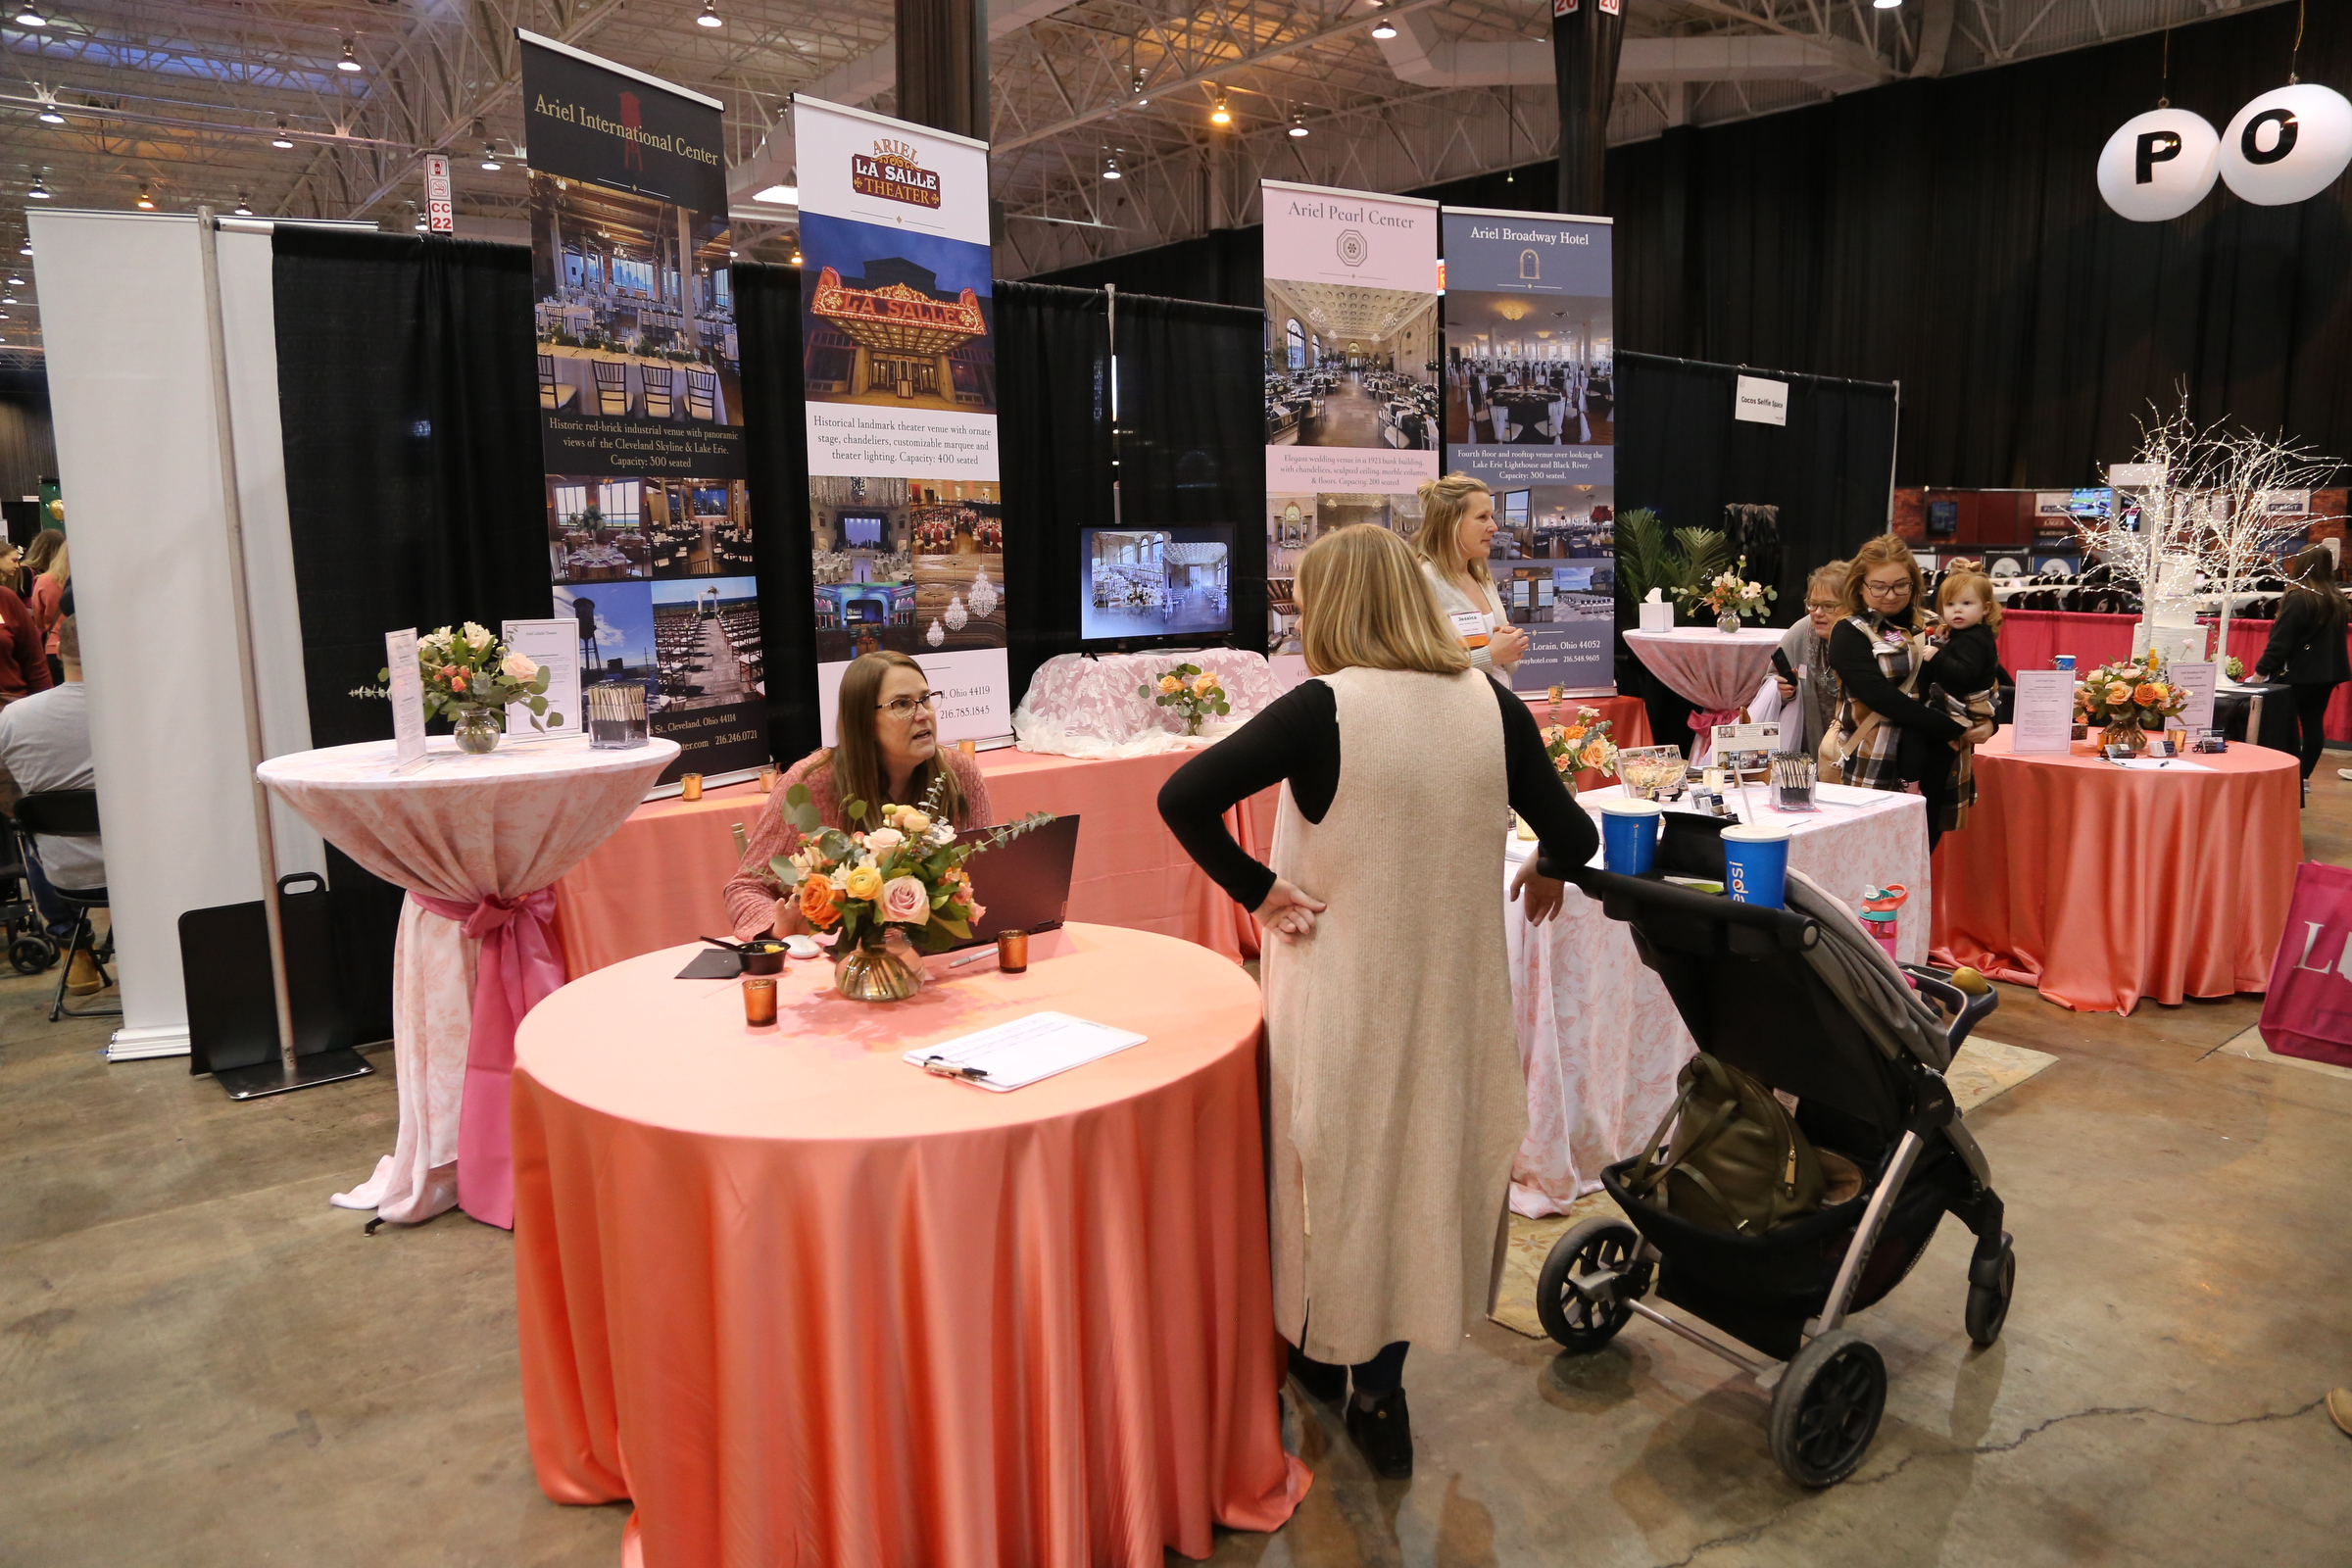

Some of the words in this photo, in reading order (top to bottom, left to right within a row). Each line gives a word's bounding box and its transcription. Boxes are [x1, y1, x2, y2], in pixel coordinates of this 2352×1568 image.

[534, 93, 575, 123] Ariel
[579, 106, 672, 152] International
[675, 137, 718, 166] Center
[873, 138, 919, 165] ARIEL
[2135, 130, 2182, 185] P
[2240, 108, 2299, 166] O
[856, 158, 880, 177] LA
[884, 166, 937, 190] SALLE
[863, 177, 930, 204] THEATER
[431, 202, 451, 214] CC
[1289, 201, 1324, 219] Ariel
[1329, 205, 1364, 222] Pearl
[1368, 210, 1414, 228] Center
[432, 217, 452, 229] 22
[1470, 226, 1499, 240] Ariel
[1502, 227, 1557, 245] Broadway
[1559, 231, 1590, 245] Hotel
[843, 294, 877, 315] LA
[886, 300, 959, 325] SALLE
[1740, 396, 1757, 405] Cocos
[1757, 398, 1771, 407] Selfie
[549, 417, 583, 431] Historic
[585, 419, 622, 433] red-brick
[624, 422, 662, 435] industrial
[662, 428, 685, 437] venue
[686, 426, 703, 438] with
[704, 429, 739, 440] panoramic
[813, 416, 856, 428] Historical
[858, 418, 896, 430] landmark
[898, 421, 925, 432] theater
[951, 424, 967, 435] with
[968, 427, 992, 436] ornate
[563, 437, 585, 447] views
[587, 437, 596, 447] of
[600, 438, 613, 449] the
[614, 438, 654, 451] Cleveland
[656, 439, 684, 454] Skyline
[685, 442, 692, 453] &
[694, 443, 711, 454] Lake
[712, 444, 729, 455] Erie.
[817, 435, 841, 445] stage,
[843, 434, 892, 447] chandeliers,
[893, 438, 943, 449] customizable
[944, 442, 975, 453] marquee
[976, 441, 989, 451] and
[611, 454, 648, 468] Capacity:
[650, 456, 667, 466] 300
[668, 458, 692, 467] seated
[832, 450, 861, 461] theater
[863, 451, 898, 464] lighting.
[900, 452, 936, 465] Capacity:
[937, 454, 955, 464] 400
[956, 455, 979, 465] seated
[1284, 454, 1308, 466] Elegant
[1309, 455, 1336, 466] wedding
[1382, 457, 1397, 466] bank
[1457, 449, 1480, 458] Fourth
[1481, 449, 1497, 458] floor
[1511, 450, 1535, 460] rooftop
[1569, 451, 1592, 461] looking
[1333, 466, 1359, 476] sculpted
[1504, 461, 1539, 470] Lighthouse
[1498, 470, 1529, 481] Capacity:
[1533, 642, 1559, 651] Lorain,
[1560, 640, 1578, 650] Ohio
[1578, 640, 1601, 649] 44052
[1519, 655, 1558, 665] wayhotel.com
[1563, 655, 1600, 663] 216.548.9605
[950, 688, 967, 699] Ohio
[969, 685, 991, 696] 44119
[703, 715, 718, 726] Ohio
[719, 713, 736, 723] 44114
[940, 706, 990, 719] 216.785.1845
[680, 740, 709, 752] ter.com
[714, 729, 758, 745] 216.246.0721
[1729, 860, 1749, 903] epsi
[2292, 920, 2333, 975] L
